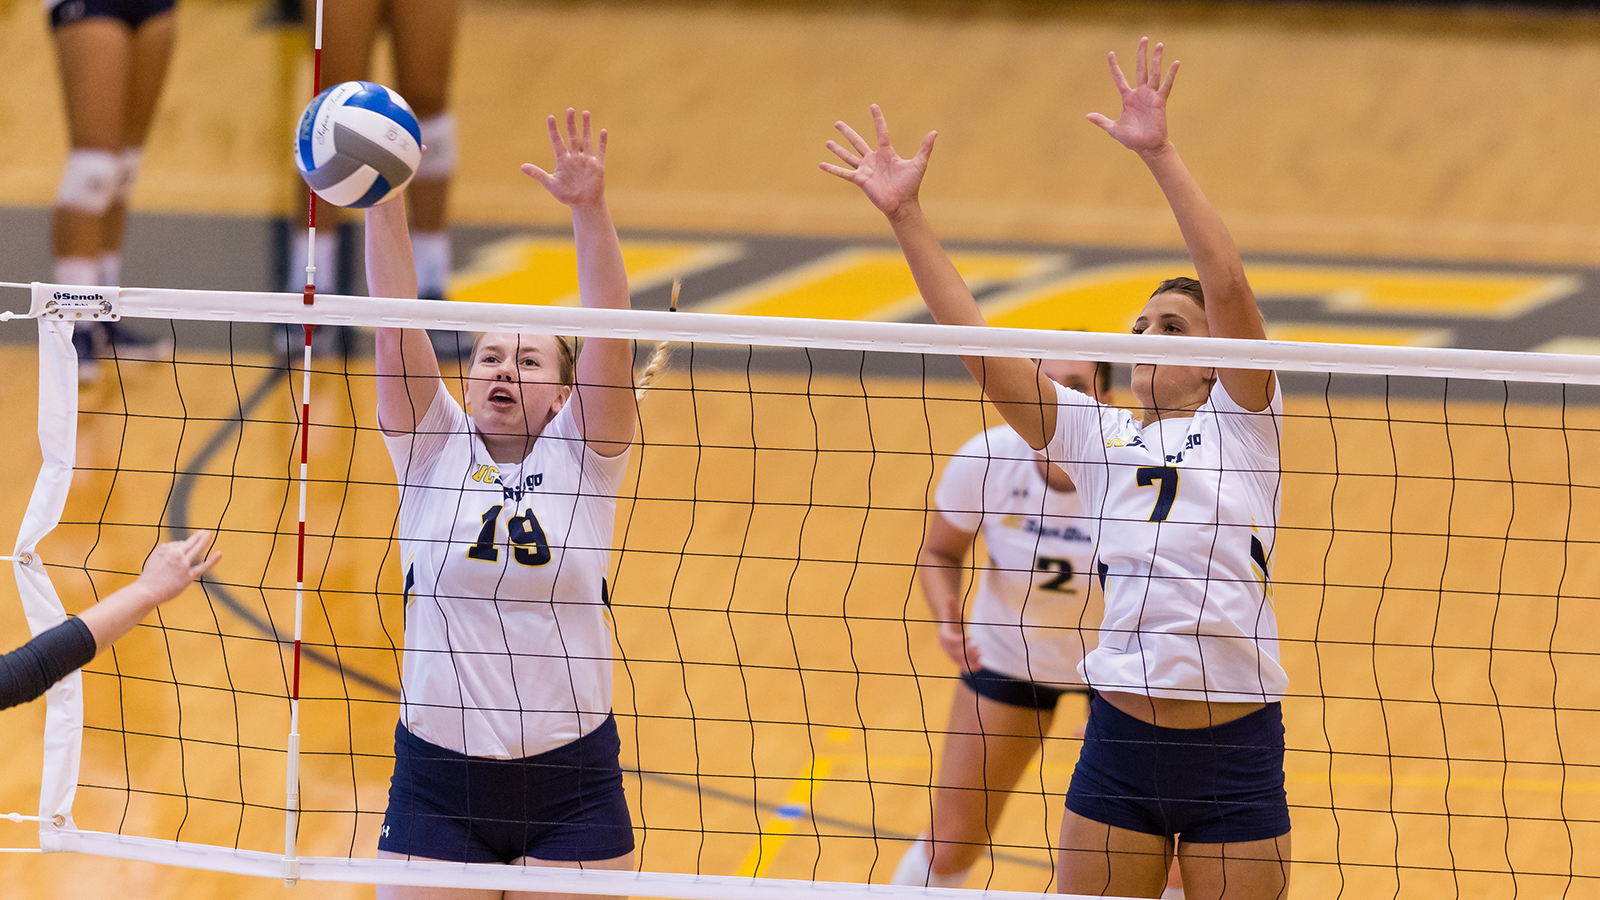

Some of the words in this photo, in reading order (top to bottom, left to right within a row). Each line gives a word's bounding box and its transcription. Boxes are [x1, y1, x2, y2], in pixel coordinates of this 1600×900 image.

[62, 292, 104, 301] Senoh
[1135, 466, 1180, 524] 7
[466, 503, 552, 567] 19
[1036, 555, 1078, 595] 2
